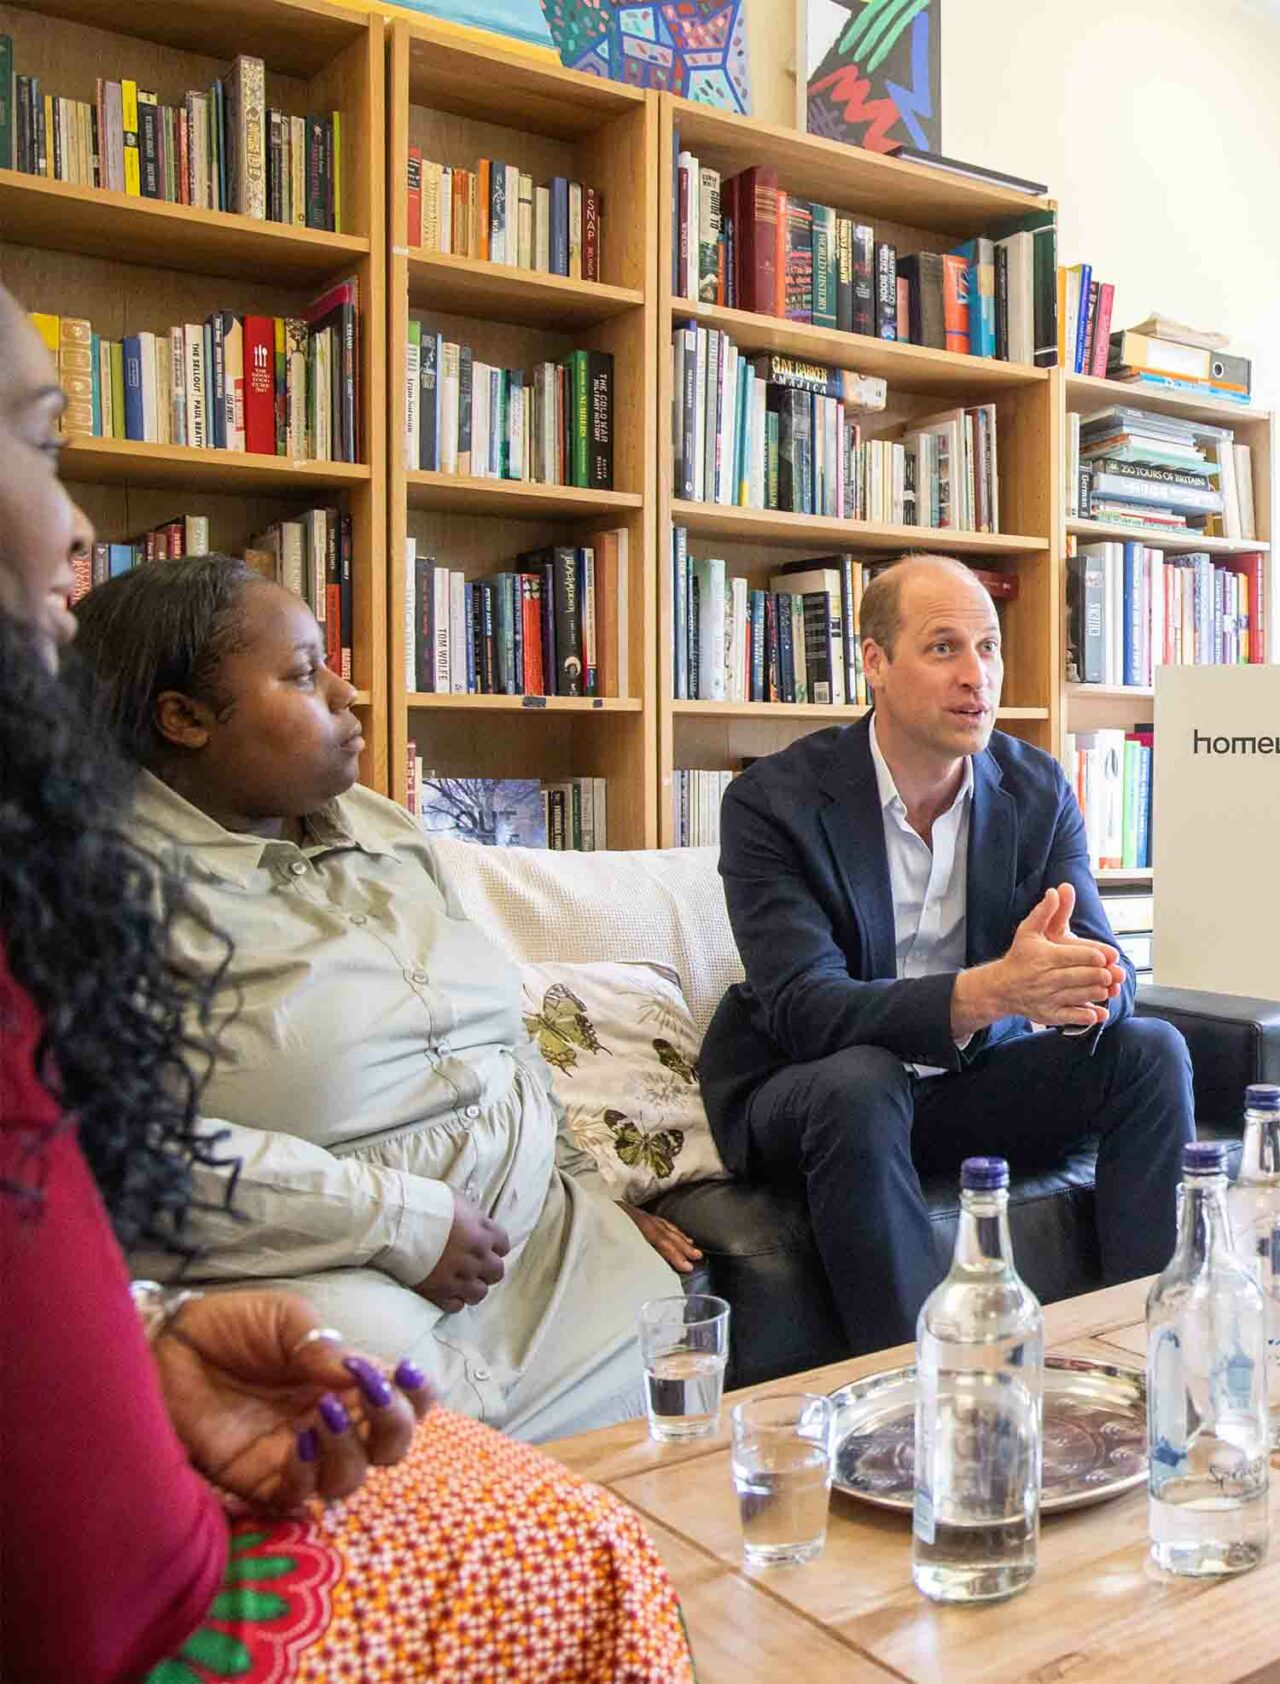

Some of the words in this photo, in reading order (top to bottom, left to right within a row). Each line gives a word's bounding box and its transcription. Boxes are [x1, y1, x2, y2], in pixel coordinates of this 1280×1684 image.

[710, 190, 720, 216] GUIDE
[586, 199, 596, 241] SNAP
[710, 218, 720, 230] TO
[817, 233, 828, 270] WORLD
[879, 247, 889, 273] QUIZ
[817, 270, 828, 312] HISTORY
[879, 275, 889, 303] BOOK
[192, 343, 200, 358] THE
[192, 359, 201, 392] SELLOUT
[600, 373, 608, 392] THE
[772, 356, 794, 376] CLIVE
[795, 360, 828, 383] BARKER
[193, 400, 202, 419] PAUL
[579, 394, 587, 438] NUMBERS
[600, 394, 608, 420] COLD
[194, 421, 203, 448] BEATTY
[600, 421, 609, 443] WAR
[1120, 464, 1135, 474] 250
[1136, 466, 1163, 480] TOURS
[1163, 471, 1174, 481] OF
[1175, 474, 1205, 486] BRITAIN
[1081, 474, 1090, 508] German
[81, 561, 91, 594] SALM
[437, 628, 447, 647] TOM
[341, 648, 351, 681] MARVEL
[437, 650, 447, 681] WOLFE
